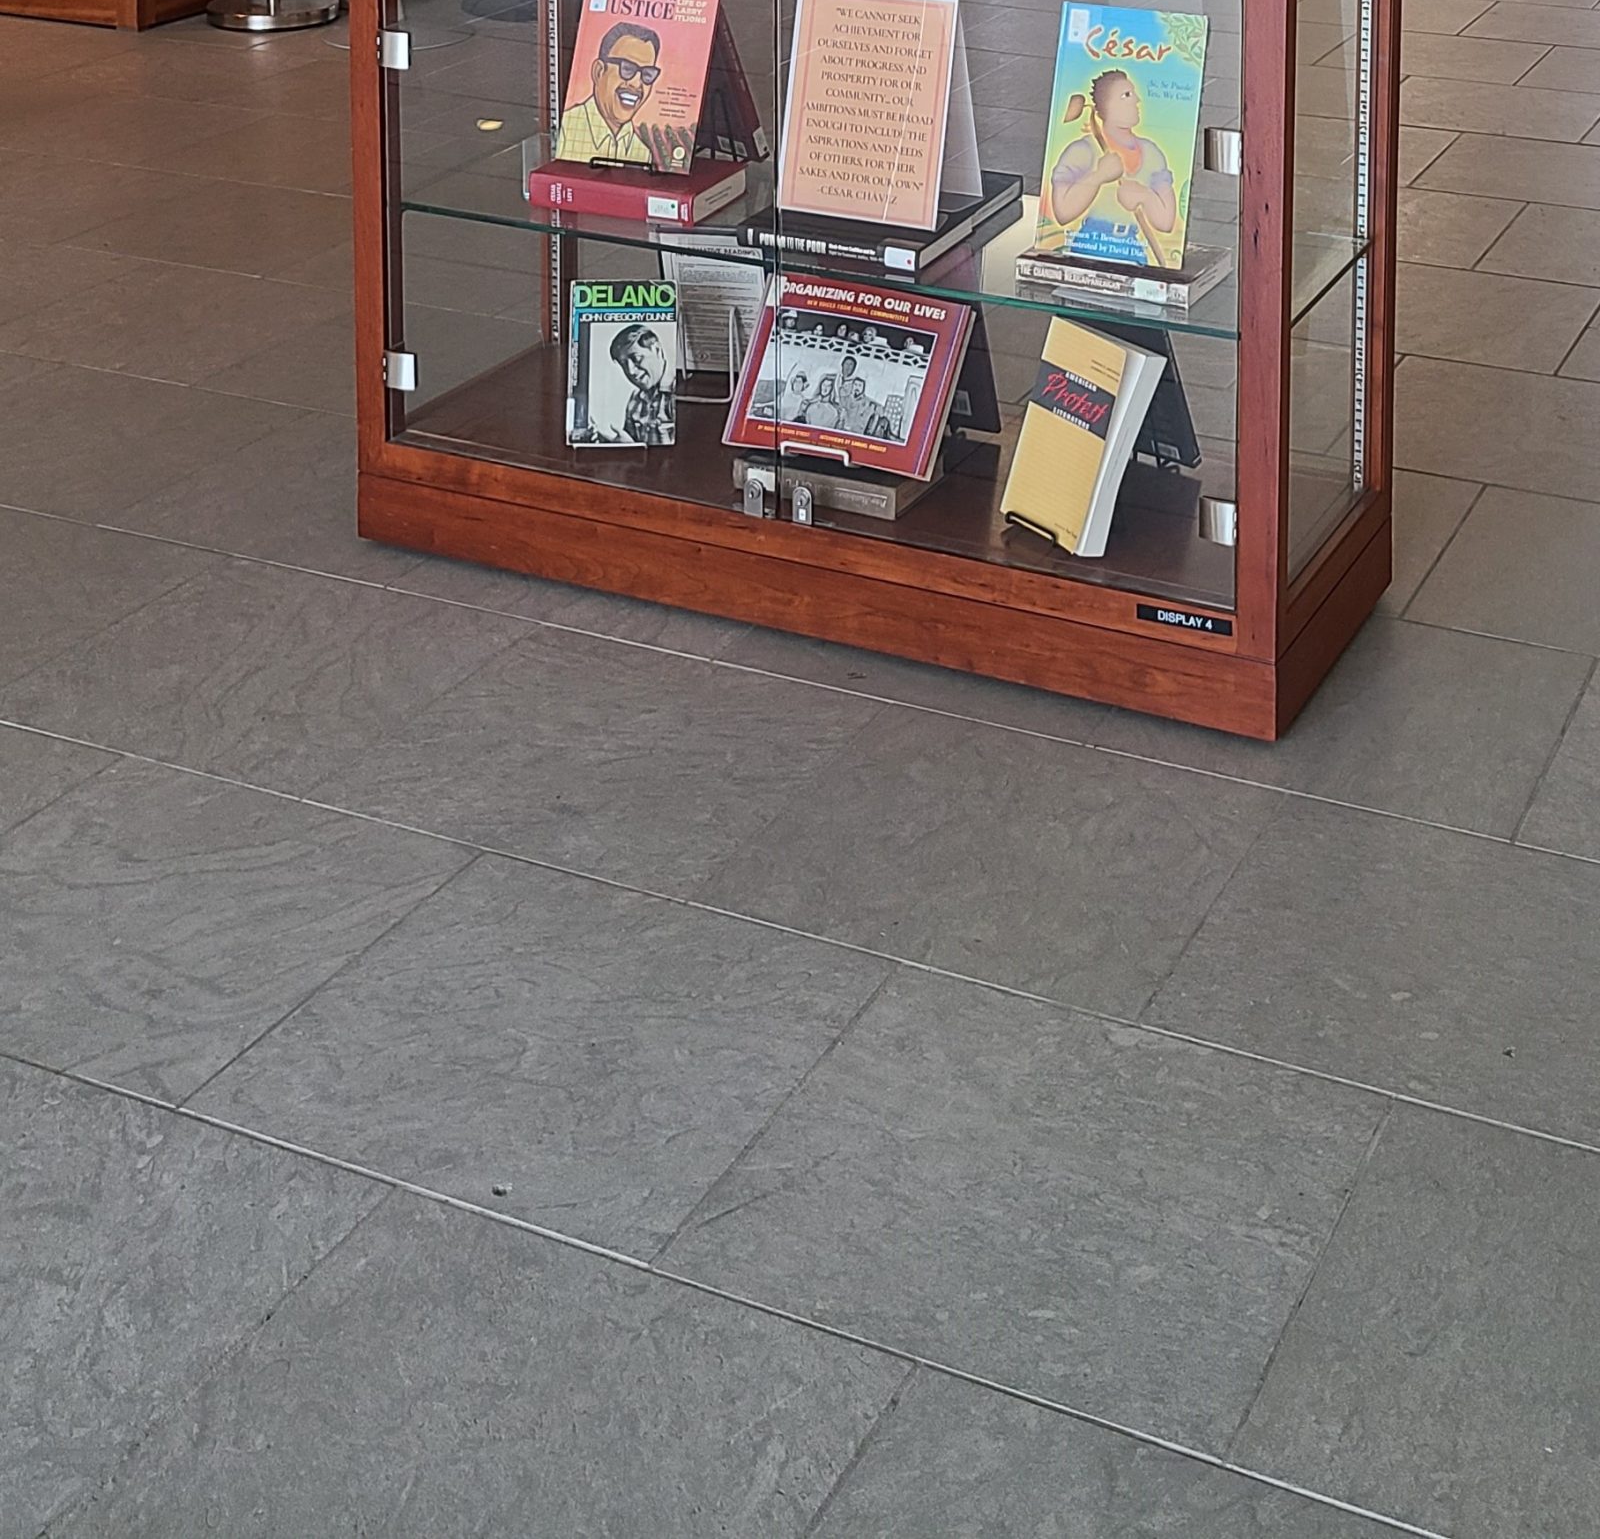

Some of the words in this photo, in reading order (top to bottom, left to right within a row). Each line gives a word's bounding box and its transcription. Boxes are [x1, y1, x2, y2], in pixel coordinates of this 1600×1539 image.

[676, 7, 703, 15] LARRY
[677, 0, 695, 7] LIFE
[855, 10, 897, 23] CANNOT
[898, 14, 921, 25] SEEK
[832, 23, 901, 39] ACHIEVEMENT
[901, 30, 921, 41] FOR
[817, 38, 871, 52] OURSELVES
[871, 44, 894, 55] AND
[894, 47, 933, 60] FORGET
[1086, 26, 1172, 61] César
[820, 55, 854, 67] ABOUT
[855, 58, 904, 72] PROGRESS
[904, 64, 927, 75] AND
[820, 70, 878, 86] PROSPERITY
[879, 77, 899, 88] FOR
[900, 80, 922, 92] OUR
[804, 102, 856, 116] AMBITIONS
[858, 108, 885, 120] MUST
[886, 112, 897, 121] BE
[898, 113, 934, 126] BROAD
[806, 118, 847, 131] ENOUGH
[849, 124, 863, 132] TO
[908, 131, 928, 142] THE
[806, 134, 868, 150] ASPIRATIONS
[871, 143, 892, 154] AND
[893, 146, 924, 158] NEEDS
[809, 151, 823, 161] OF
[864, 159, 885, 170] FOR
[886, 161, 916, 174] THEIR
[798, 166, 828, 178] SAKES
[830, 170, 850, 180] AND
[851, 172, 871, 183] FOR
[806, 239, 827, 254] POOR
[1099, 241, 1107, 252] by
[1109, 243, 1129, 256] David
[574, 284, 676, 307] DELANO
[782, 282, 855, 303] ORGANIZING
[858, 292, 881, 308] FOR
[884, 297, 911, 314] OUR
[913, 304, 947, 321] LIVES
[580, 312, 602, 321] JOHN
[603, 312, 646, 321] GREGORY
[646, 312, 675, 321] DUNNE
[1065, 371, 1098, 392] AMERICAN
[1041, 372, 1109, 423] Protest
[1053, 406, 1090, 430] LITERATURE
[1157, 609, 1204, 628] DISPLAY
[1205, 619, 1213, 630] 4
